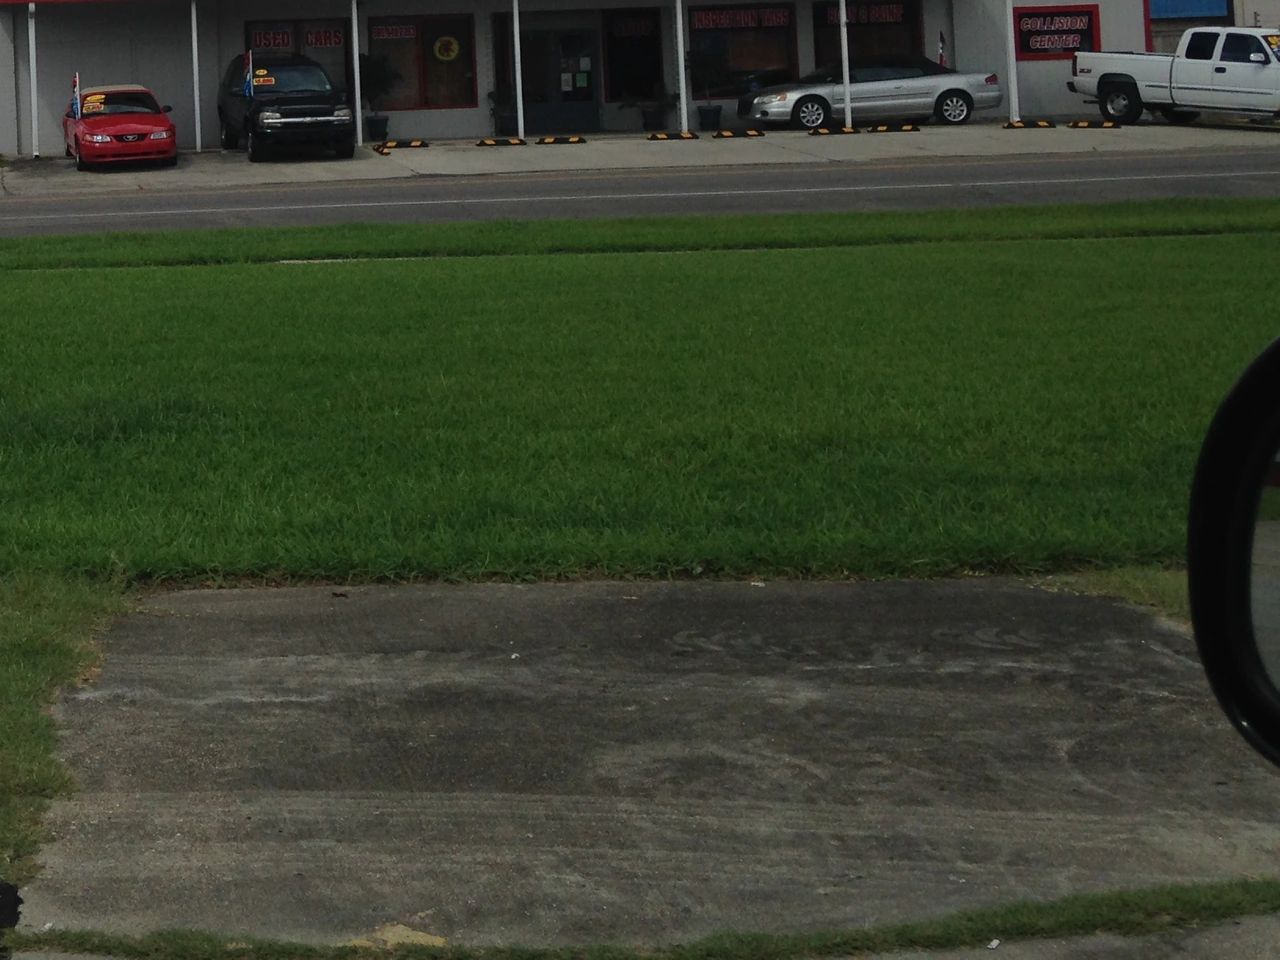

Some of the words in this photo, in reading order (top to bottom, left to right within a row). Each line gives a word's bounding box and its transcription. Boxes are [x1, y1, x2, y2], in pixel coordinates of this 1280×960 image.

[1021, 16, 1088, 31] COLLISION
[254, 31, 290, 48] USED
[305, 30, 343, 48] CARS
[1030, 34, 1080, 49] CENTER
